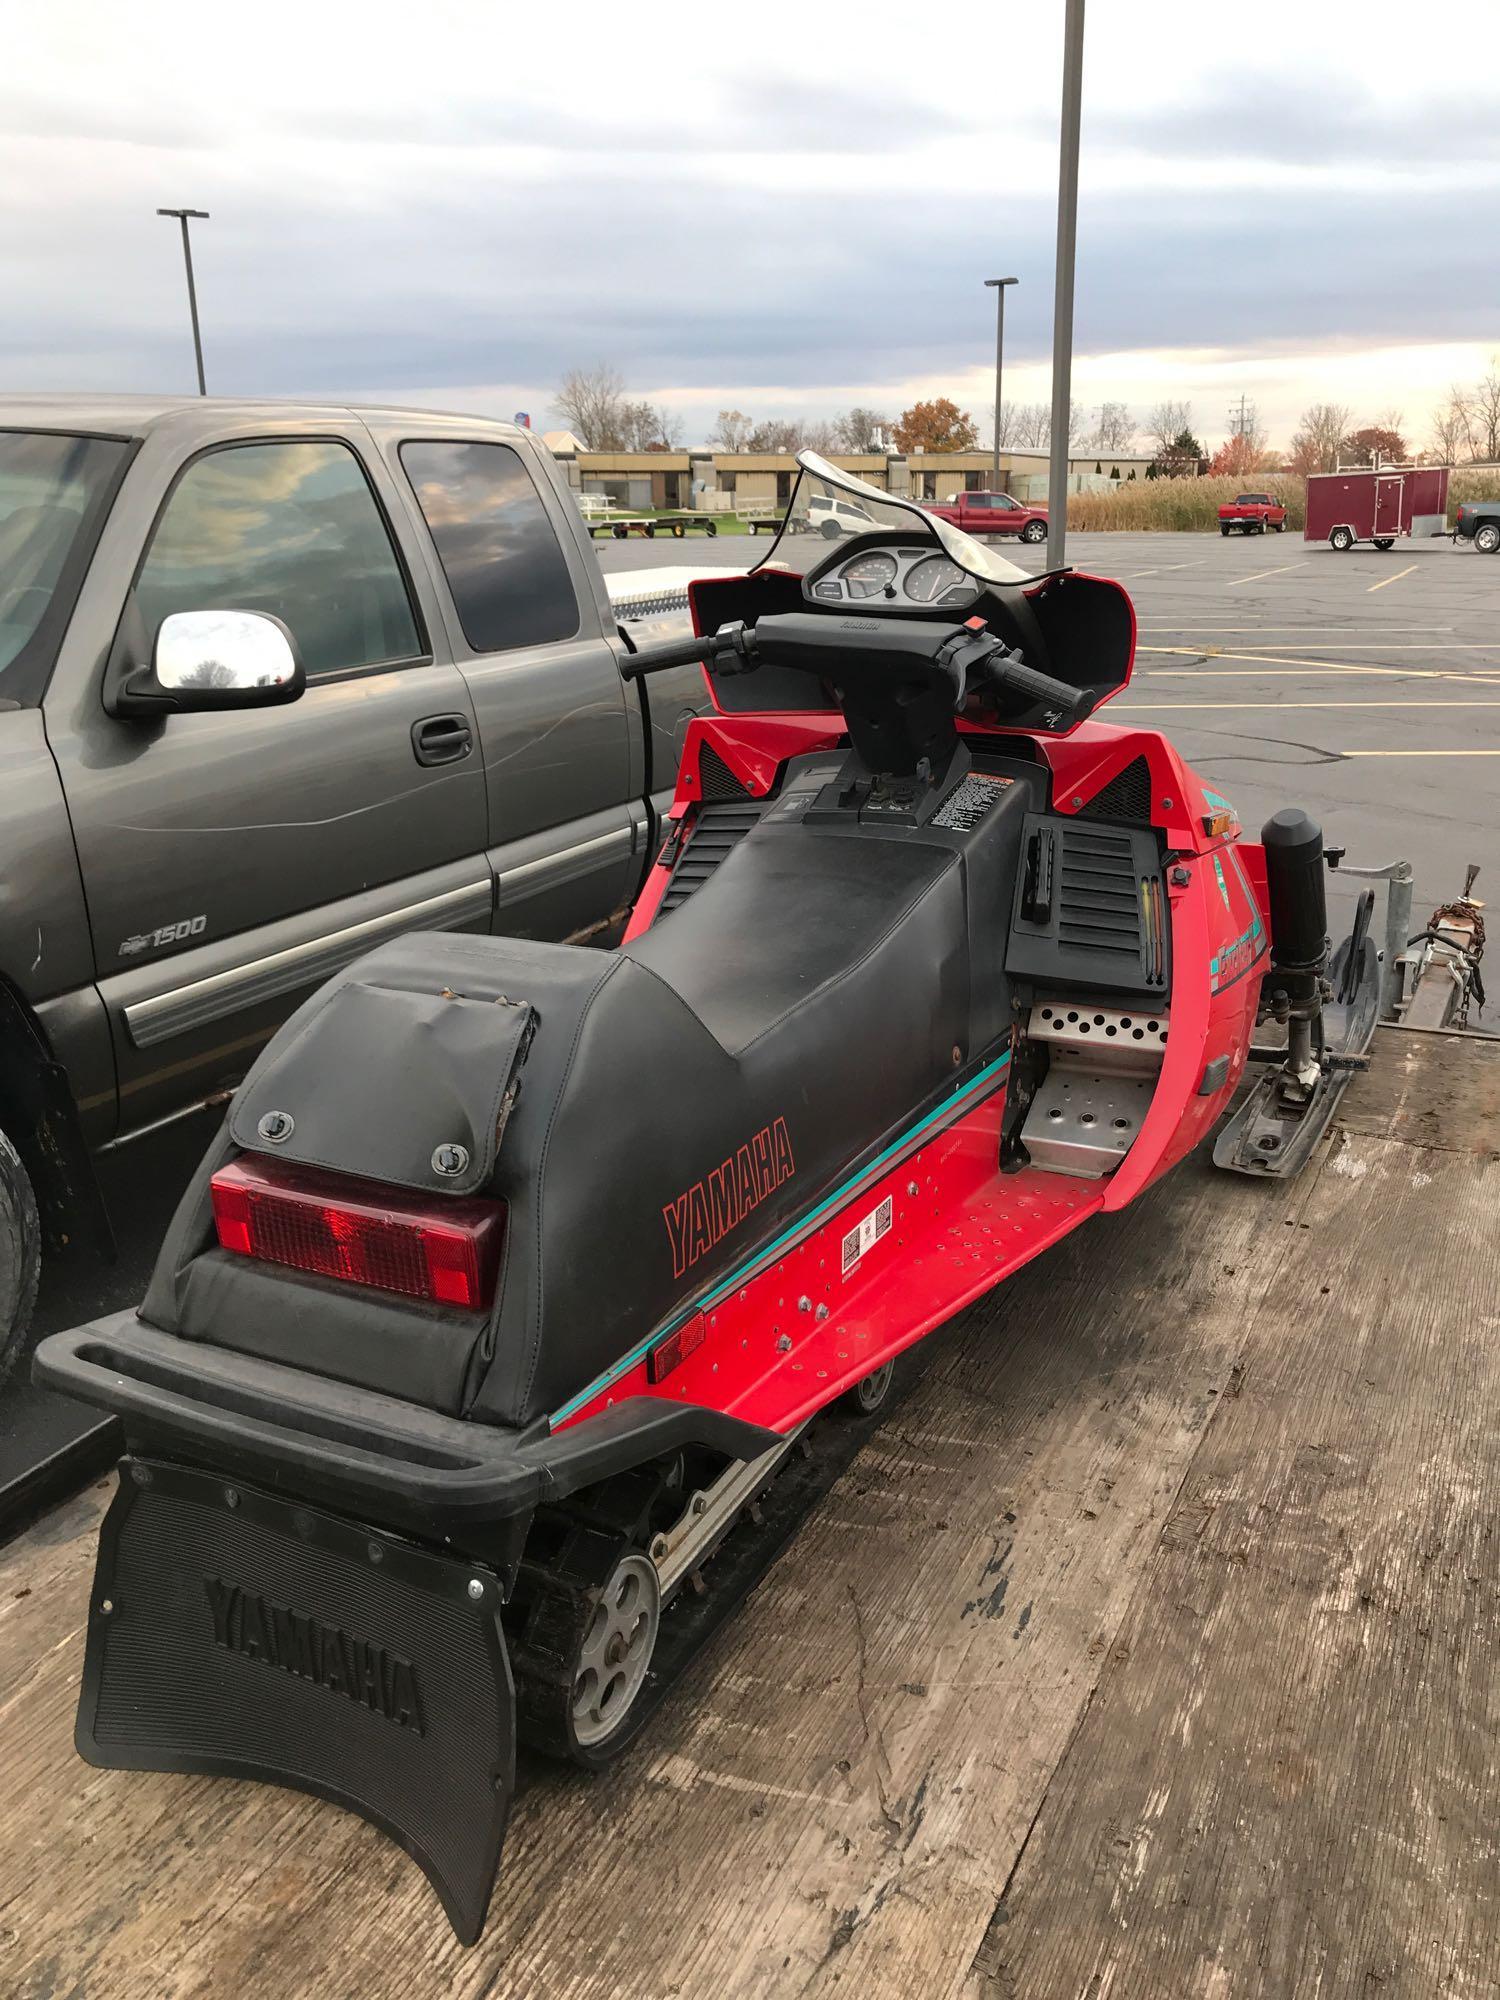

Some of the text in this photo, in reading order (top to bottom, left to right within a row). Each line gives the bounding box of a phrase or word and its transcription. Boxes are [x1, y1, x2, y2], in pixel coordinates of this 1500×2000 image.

[153, 914, 207, 947] 1500
[662, 1116, 795, 1279] YAMAHA
[203, 1574, 426, 1738] YAMAHA
